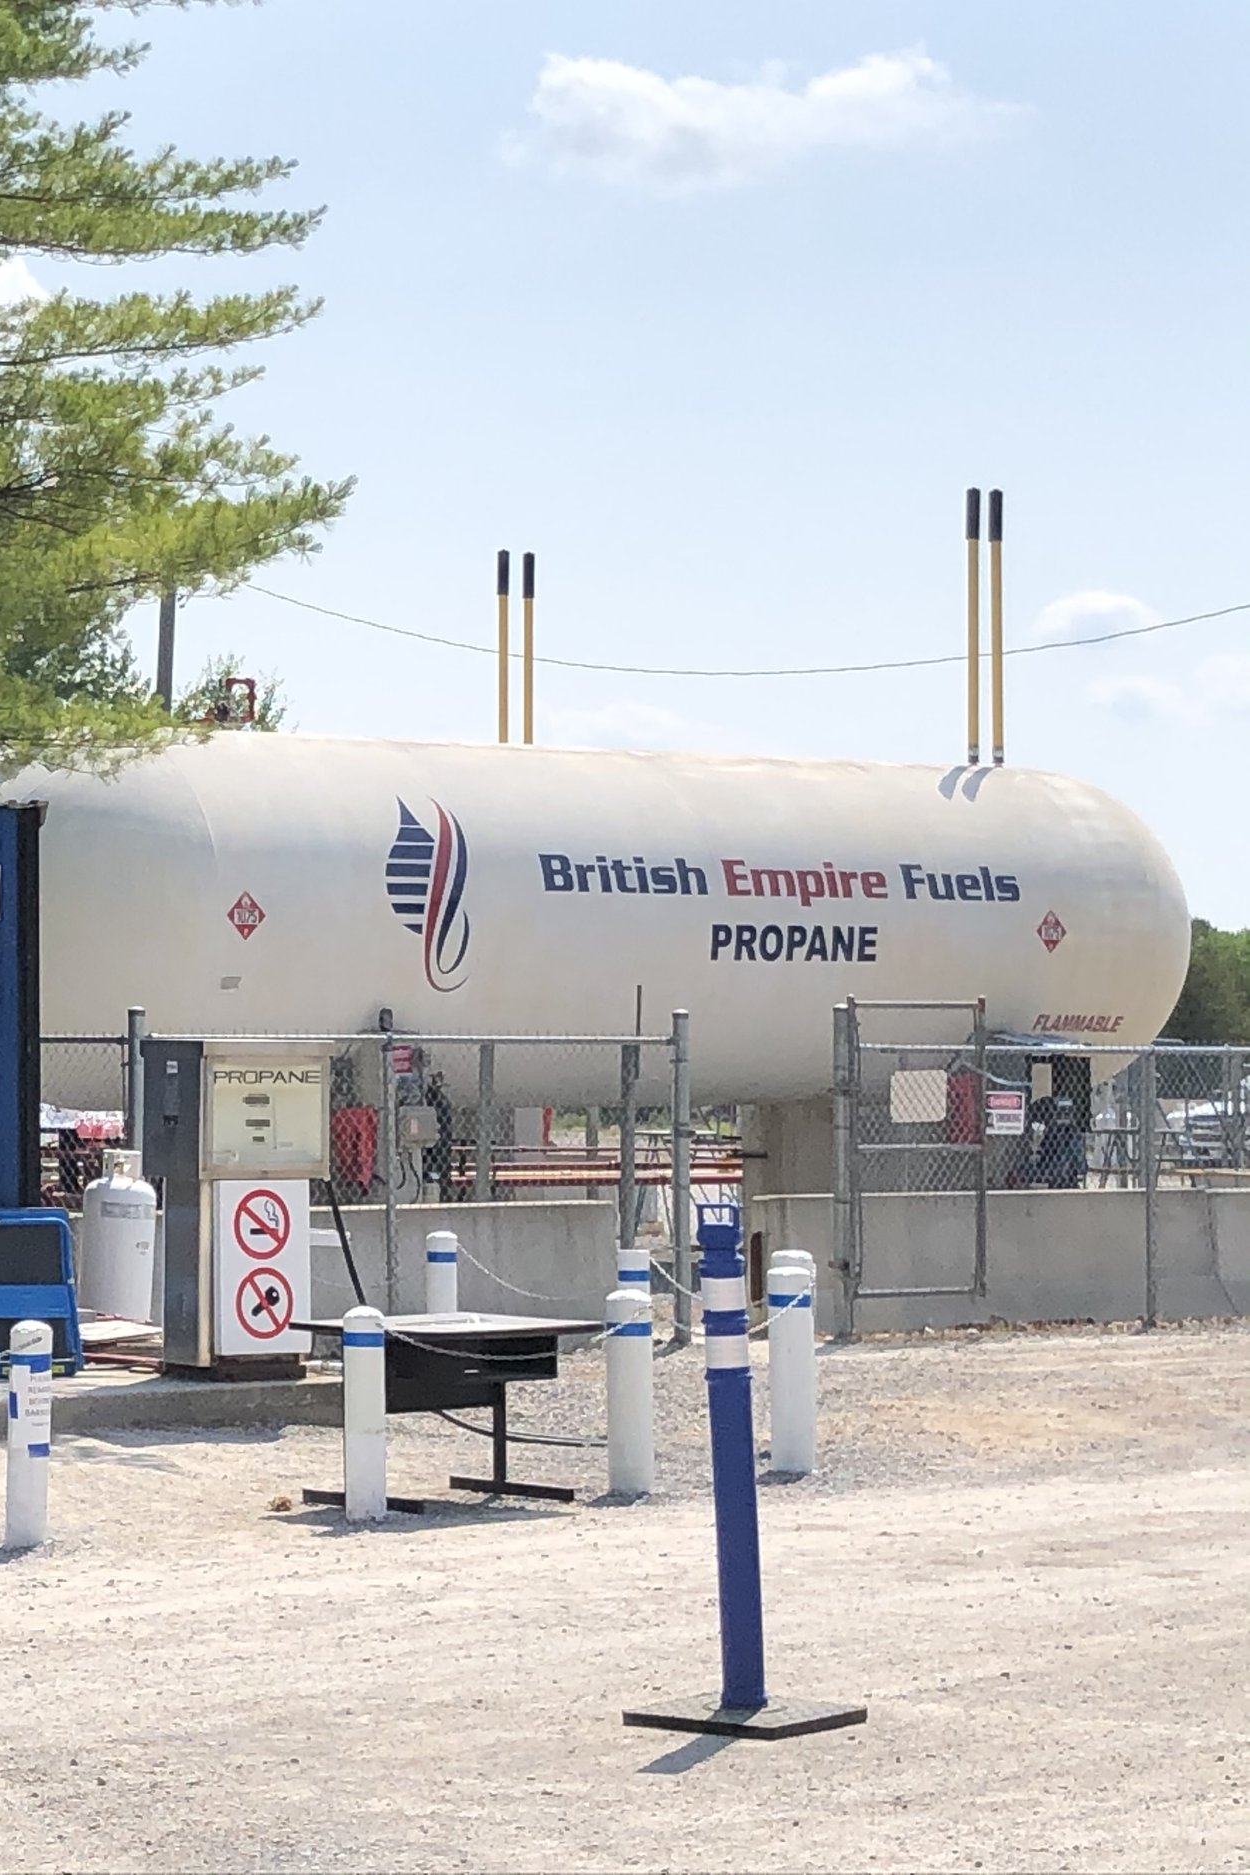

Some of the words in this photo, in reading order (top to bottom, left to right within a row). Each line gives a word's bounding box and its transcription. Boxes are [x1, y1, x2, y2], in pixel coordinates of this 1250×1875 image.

[538, 853, 709, 896] British
[721, 859, 889, 907] Empire
[899, 864, 1021, 902] Fuels
[710, 923, 878, 963] PROPANE
[1032, 1014, 1125, 1033] FLAMMABLE
[213, 1070, 321, 1085] PROPANE
